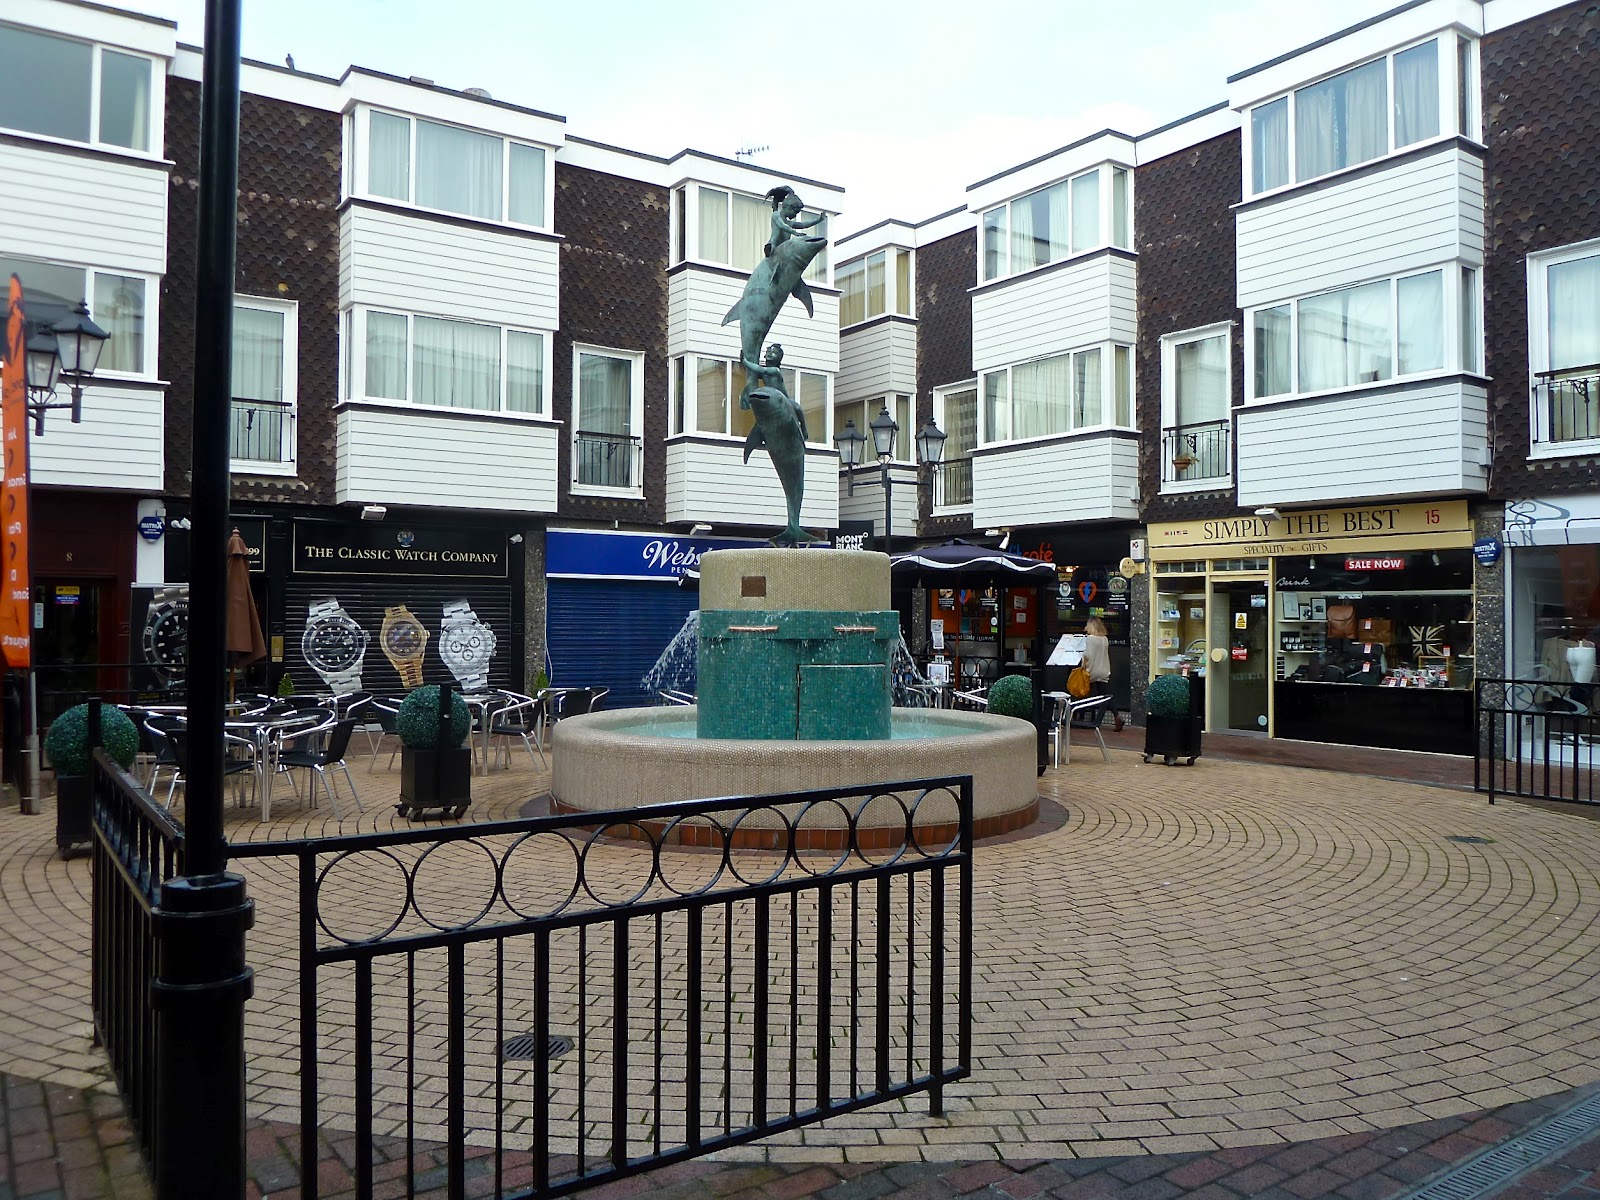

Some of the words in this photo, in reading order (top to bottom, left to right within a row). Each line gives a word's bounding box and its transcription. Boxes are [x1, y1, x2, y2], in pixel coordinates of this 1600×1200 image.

[1425, 509, 1440, 524] 15
[1204, 518, 1271, 539] SIMPLY
[1282, 514, 1329, 534] THE
[1343, 508, 1399, 531] BEST
[836, 535, 863, 543] MONT
[1244, 546, 1286, 554] SPECIALITY
[1302, 543, 1328, 552] GIFTS
[66, 552, 73, 562] 8
[305, 546, 334, 558] THE
[338, 547, 390, 560] CLASSIC
[394, 549, 437, 562] WATCH
[441, 551, 499, 563] COMPANY
[1349, 561, 1371, 569] SALE
[1374, 560, 1401, 569] NOW
